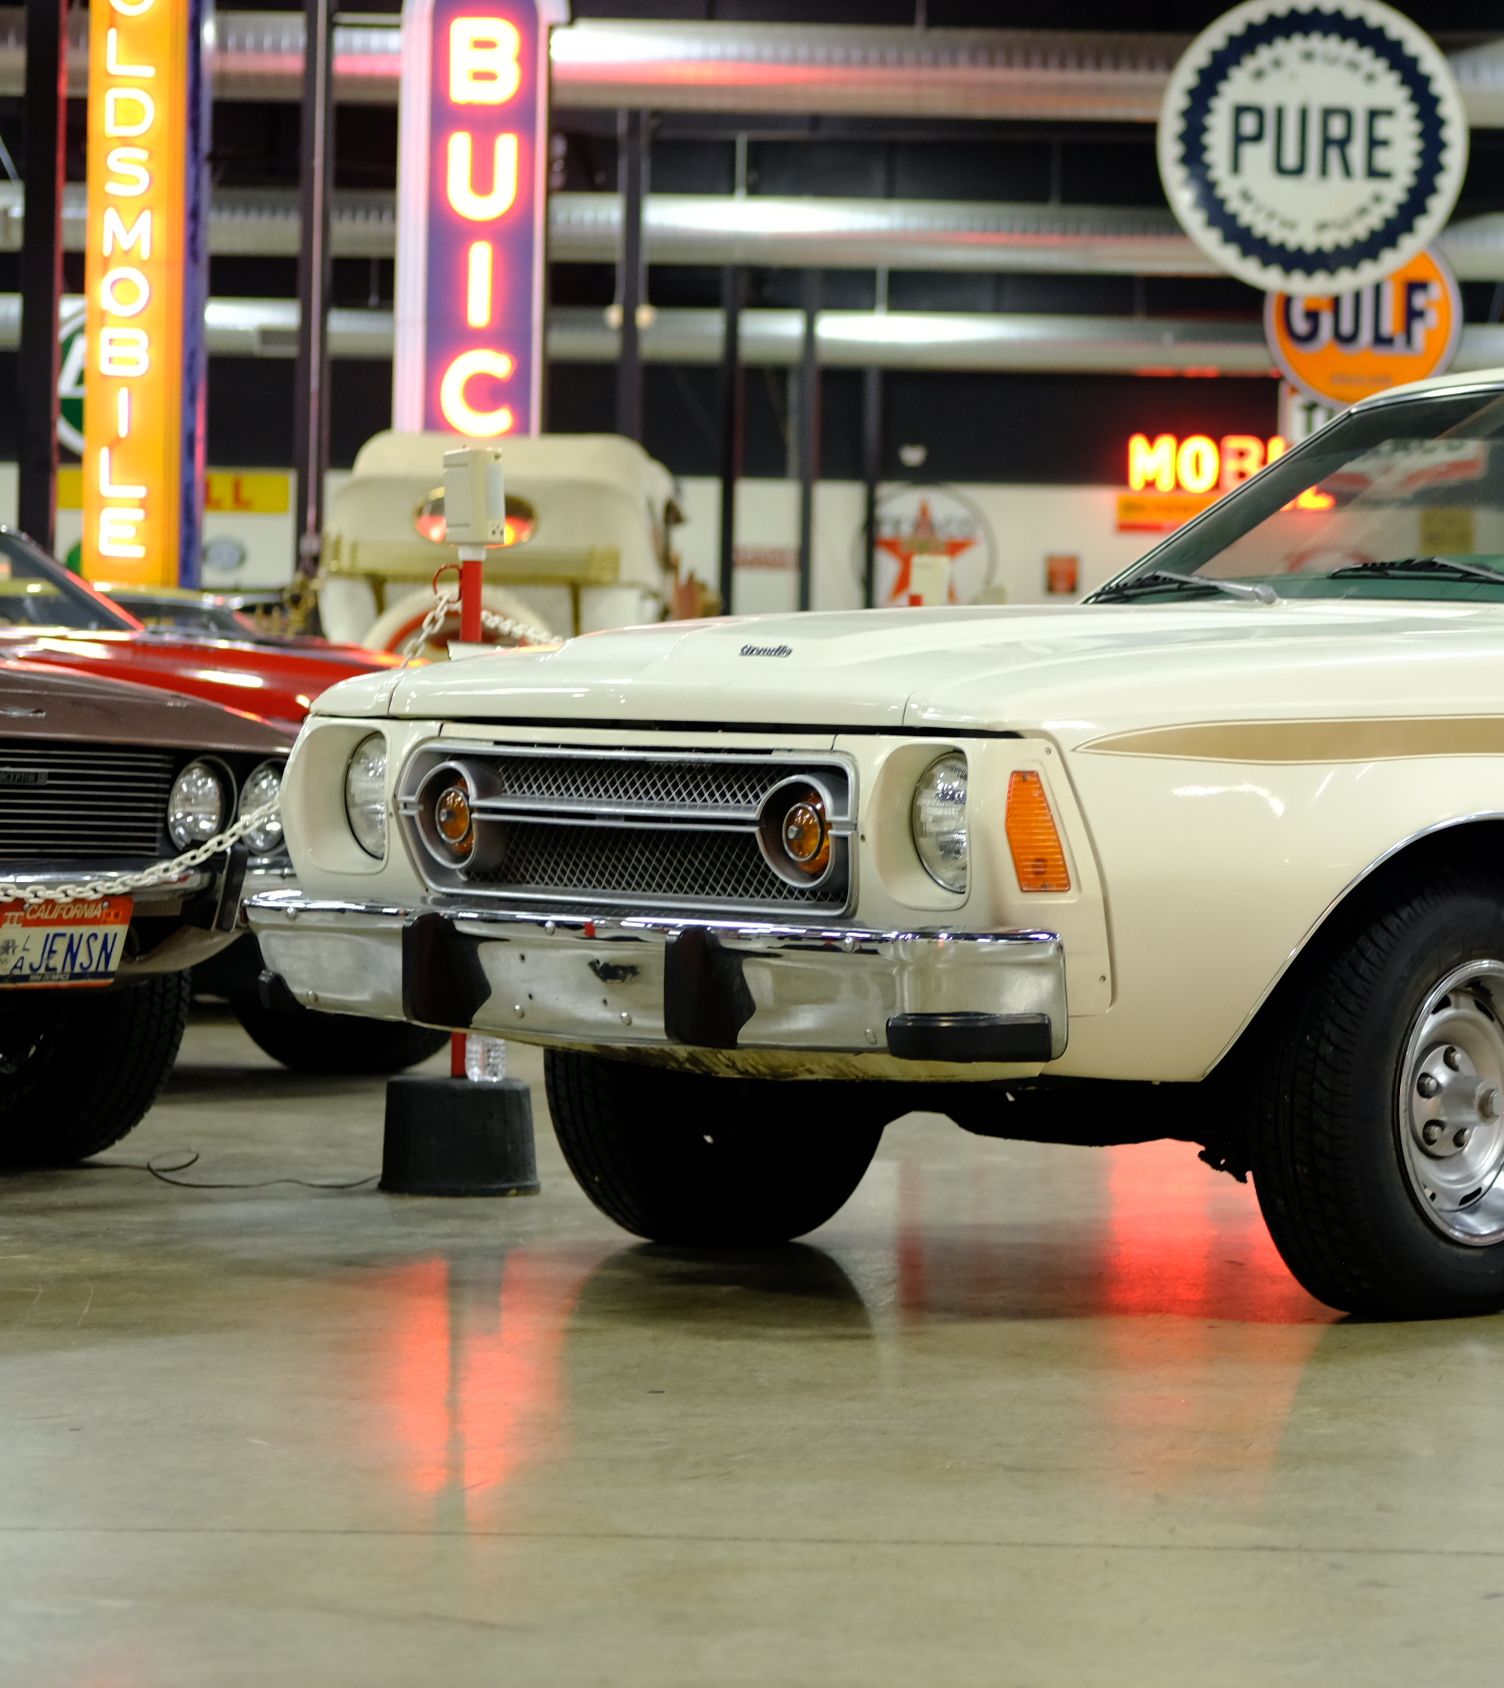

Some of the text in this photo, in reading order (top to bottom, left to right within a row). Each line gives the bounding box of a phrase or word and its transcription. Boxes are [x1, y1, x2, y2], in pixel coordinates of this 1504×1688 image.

[1231, 104, 1394, 179] PURE
[1284, 280, 1434, 350] GULF
[26, 903, 102, 919] CALIFORNIA
[29, 932, 118, 973] JENSN
